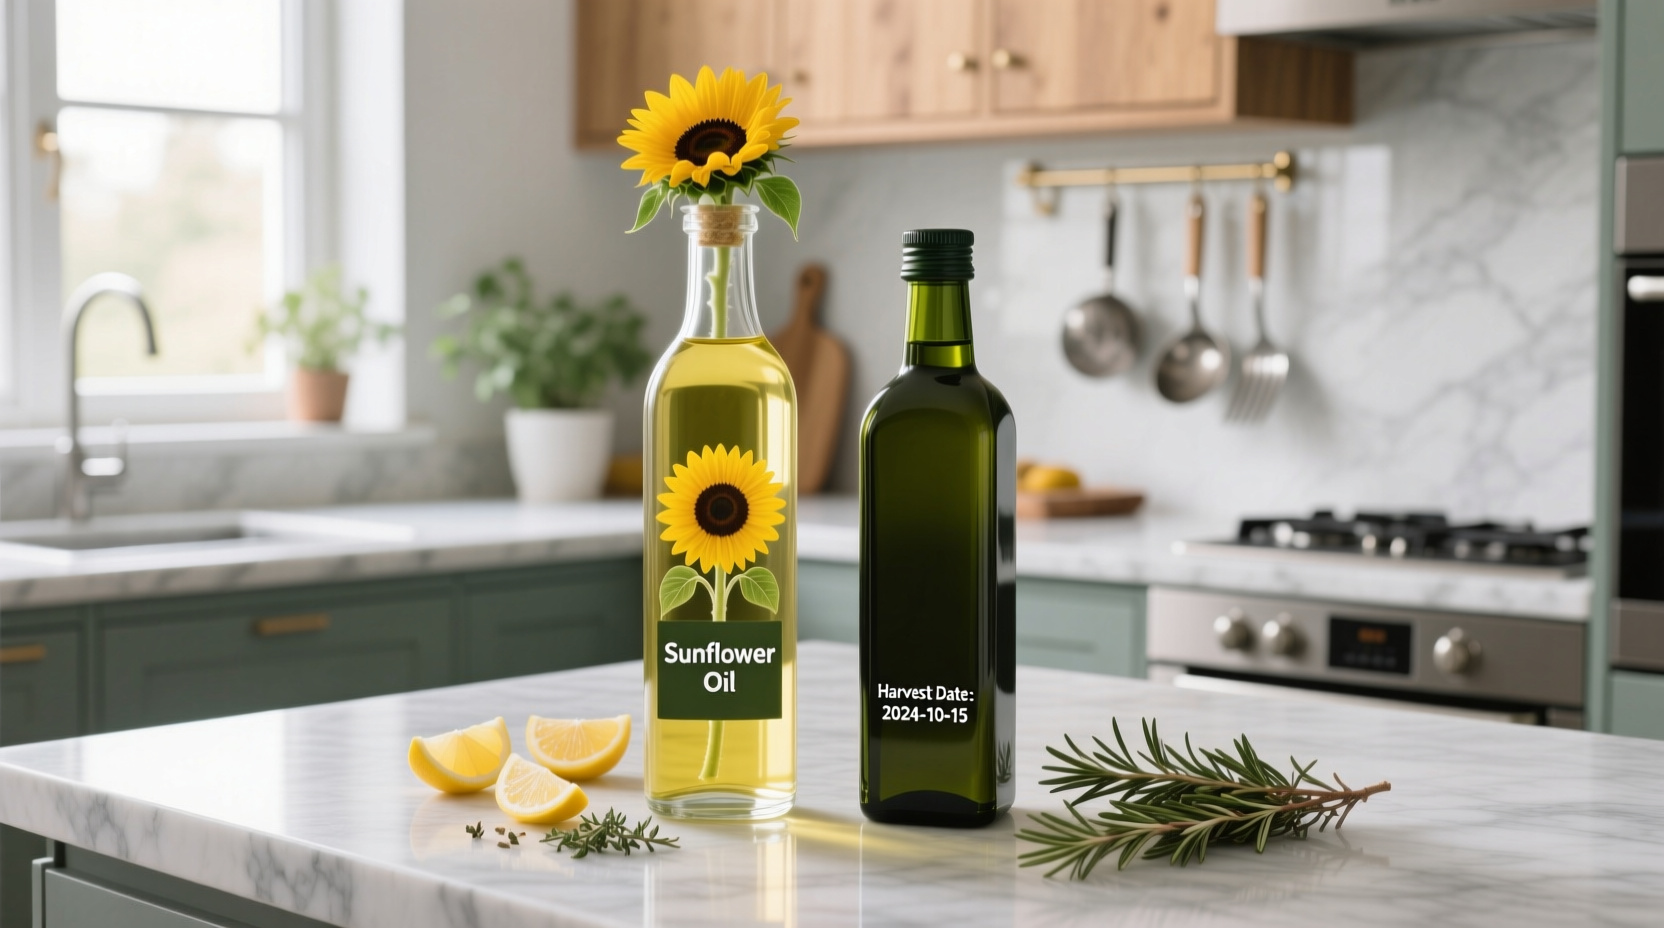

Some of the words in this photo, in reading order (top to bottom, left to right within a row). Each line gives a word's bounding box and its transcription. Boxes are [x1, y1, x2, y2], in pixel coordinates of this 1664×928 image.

[664, 641, 776, 664] Sunflower
[703, 670, 736, 693] Oil
[877, 683, 933, 701] Harvest
[936, 686, 974, 702] Date:
[881, 705, 968, 724] 2024-10-15
